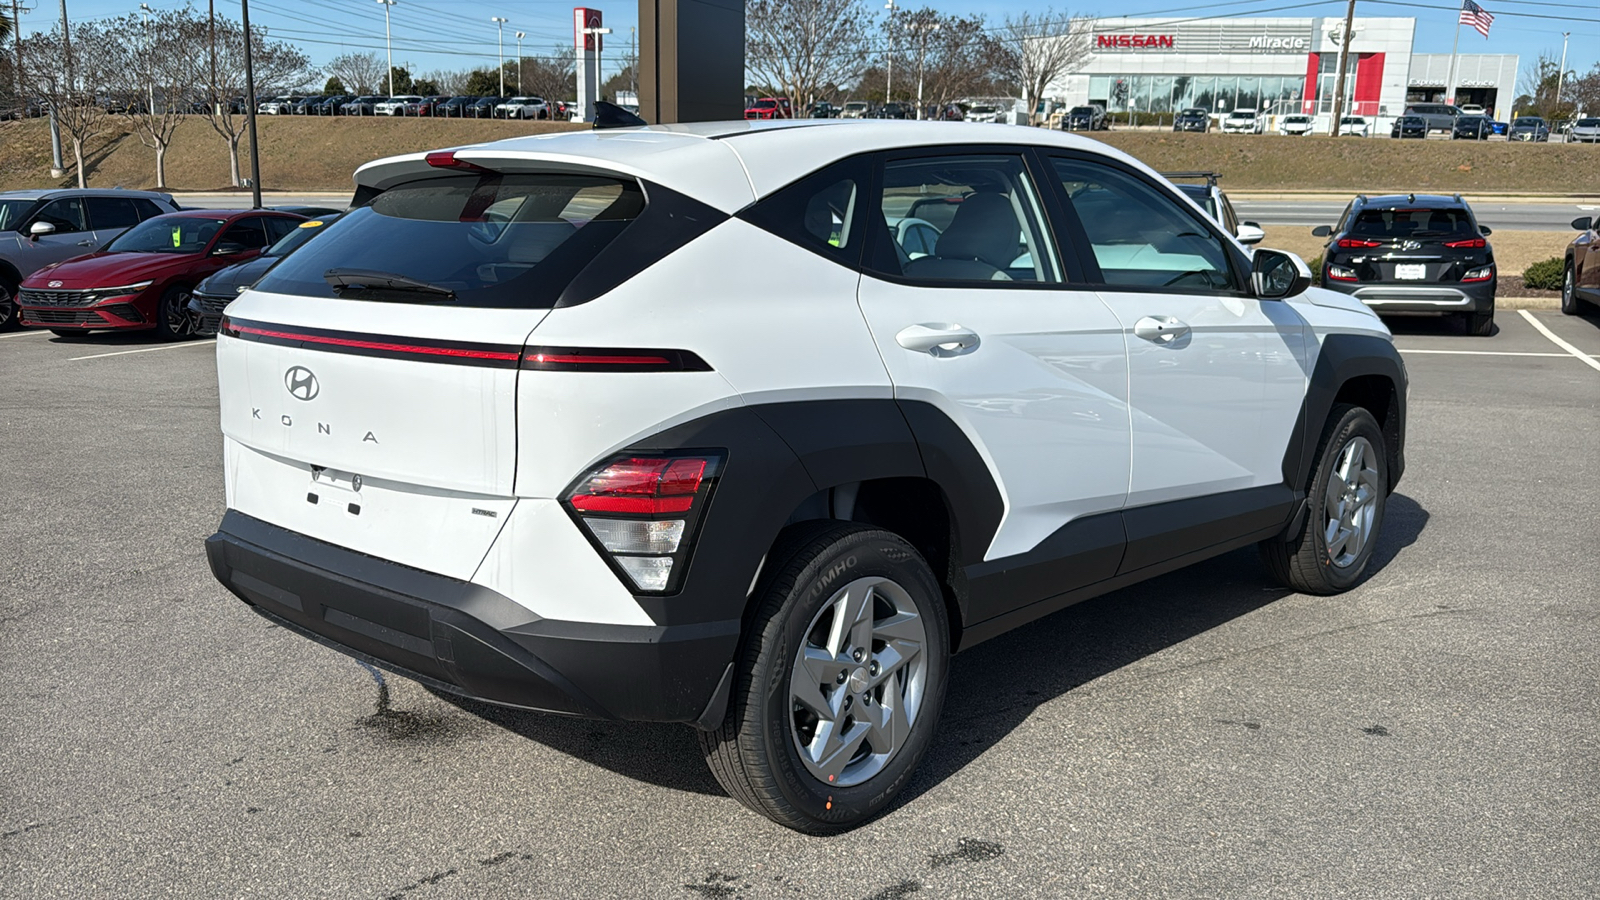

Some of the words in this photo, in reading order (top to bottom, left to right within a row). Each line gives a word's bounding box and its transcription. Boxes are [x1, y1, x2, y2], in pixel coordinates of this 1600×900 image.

[1096, 35, 1174, 48] NISSAN
[1249, 36, 1304, 49] Miracle
[1409, 77, 1445, 87] Express
[1461, 77, 1495, 87] Service
[252, 407, 379, 444] KONA
[471, 507, 498, 518] HTRAC
[803, 555, 858, 609] KUMHO
